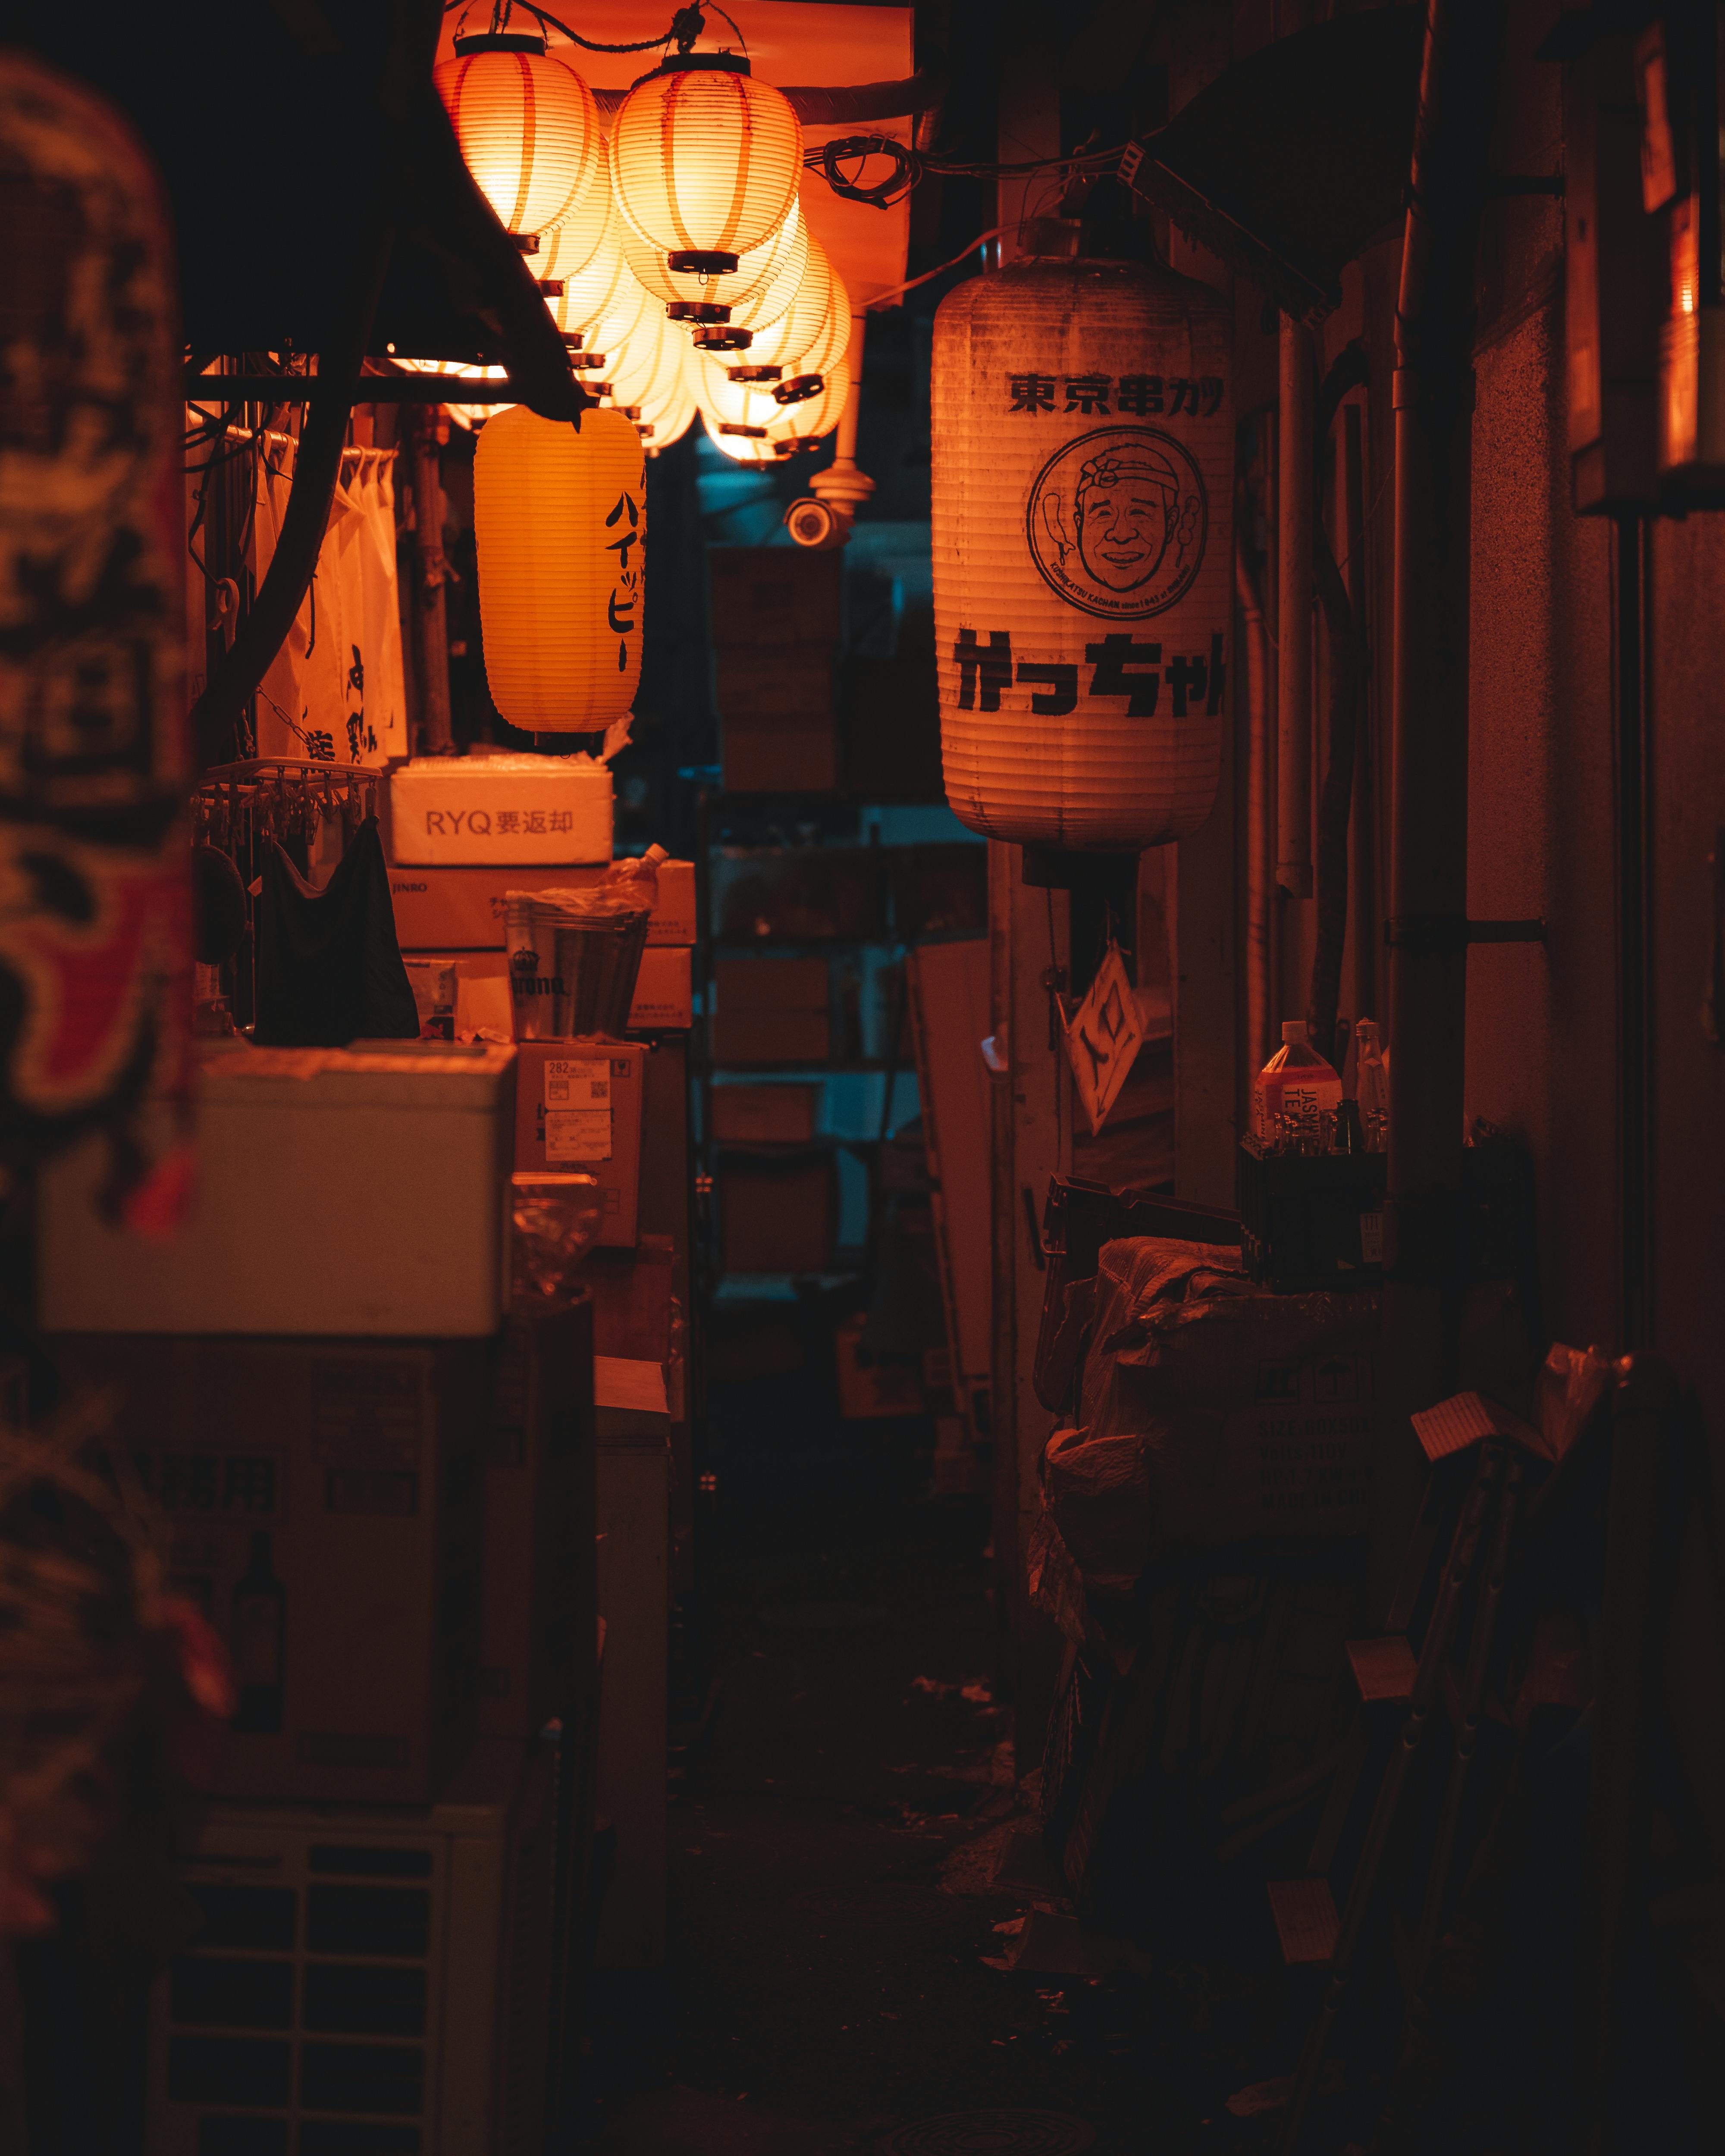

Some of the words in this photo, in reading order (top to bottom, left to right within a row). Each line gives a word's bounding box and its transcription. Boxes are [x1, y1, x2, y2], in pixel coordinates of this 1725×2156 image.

[1009, 372, 1223, 417] 東京串カツ
[1087, 593, 1120, 609] KACHAN
[426, 810, 574, 836] RYQ要返却
[392, 882, 428, 894] JINRO
[511, 975, 566, 996] orona
[549, 1062, 569, 1074] 282
[1301, 1089, 1320, 1141] JASM
